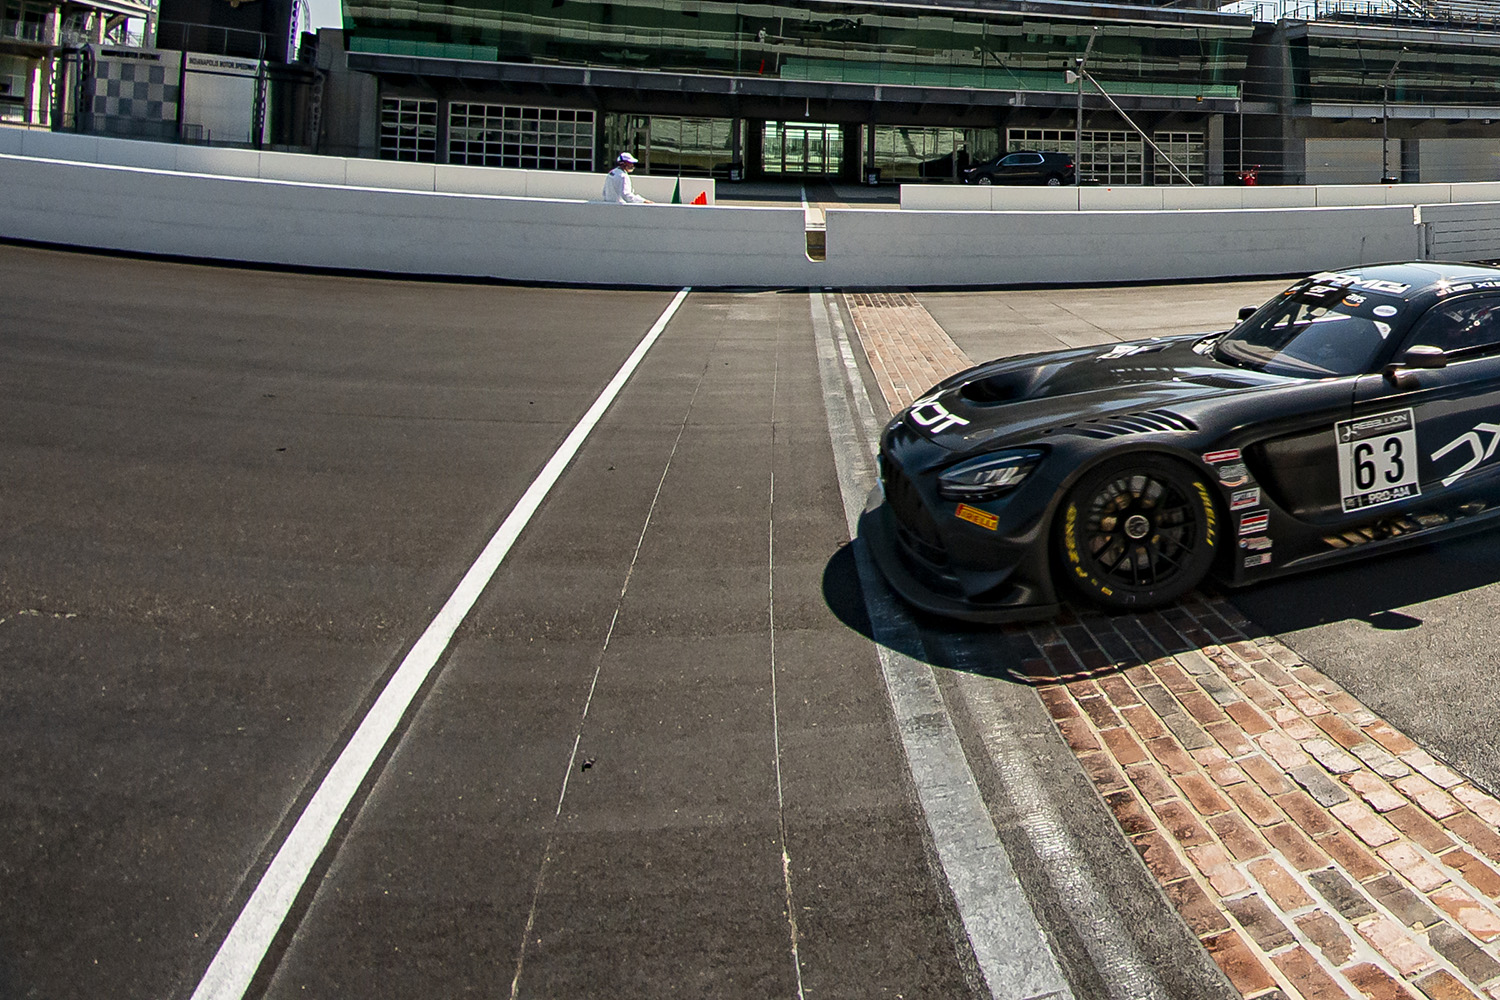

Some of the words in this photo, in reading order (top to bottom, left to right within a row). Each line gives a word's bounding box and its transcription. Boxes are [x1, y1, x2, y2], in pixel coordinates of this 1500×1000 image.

[1345, 293, 1367, 303] aws
[1352, 414, 1408, 431] REBELLION
[1354, 437, 1405, 490] 63
[1368, 486, 1411, 504] PRO-AM
